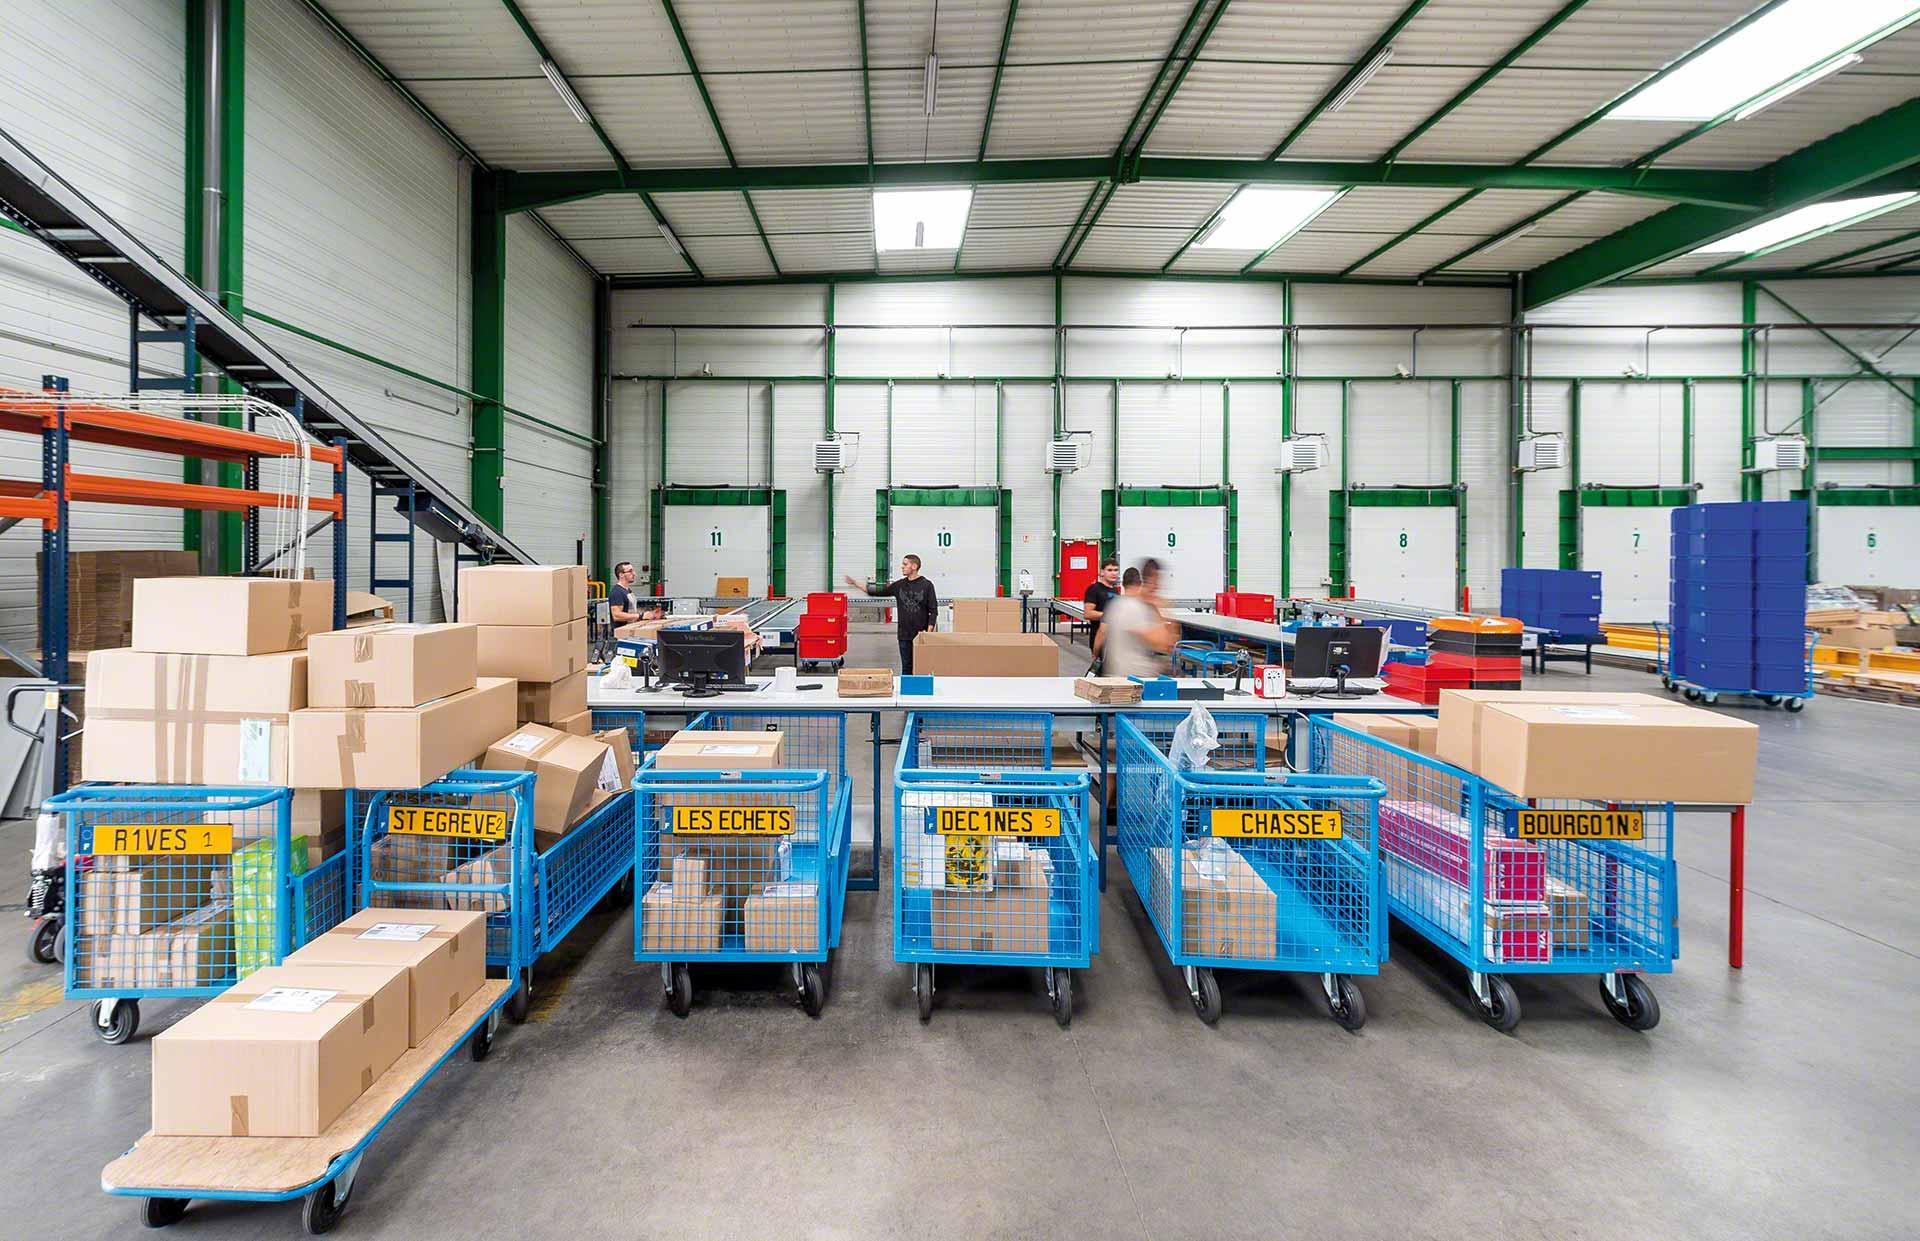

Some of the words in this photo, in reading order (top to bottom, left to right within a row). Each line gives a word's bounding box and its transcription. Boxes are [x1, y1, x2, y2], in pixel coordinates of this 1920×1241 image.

[710, 531, 722, 547] 11
[937, 532, 951, 547] 10
[1167, 532, 1176, 547] 9
[1399, 533, 1408, 548] 8
[1632, 533, 1641, 548] 7
[1867, 533, 1876, 548] 6
[393, 810, 417, 831] ST
[423, 811, 497, 835] EGREVE
[495, 817, 504, 831] 2
[677, 810, 712, 830] LES
[719, 810, 790, 830] ECHETS
[1044, 815, 1053, 829] 5
[1241, 813, 1324, 835] CHASSE
[1327, 818, 1337, 832] 7
[202, 832, 213, 847] 1
